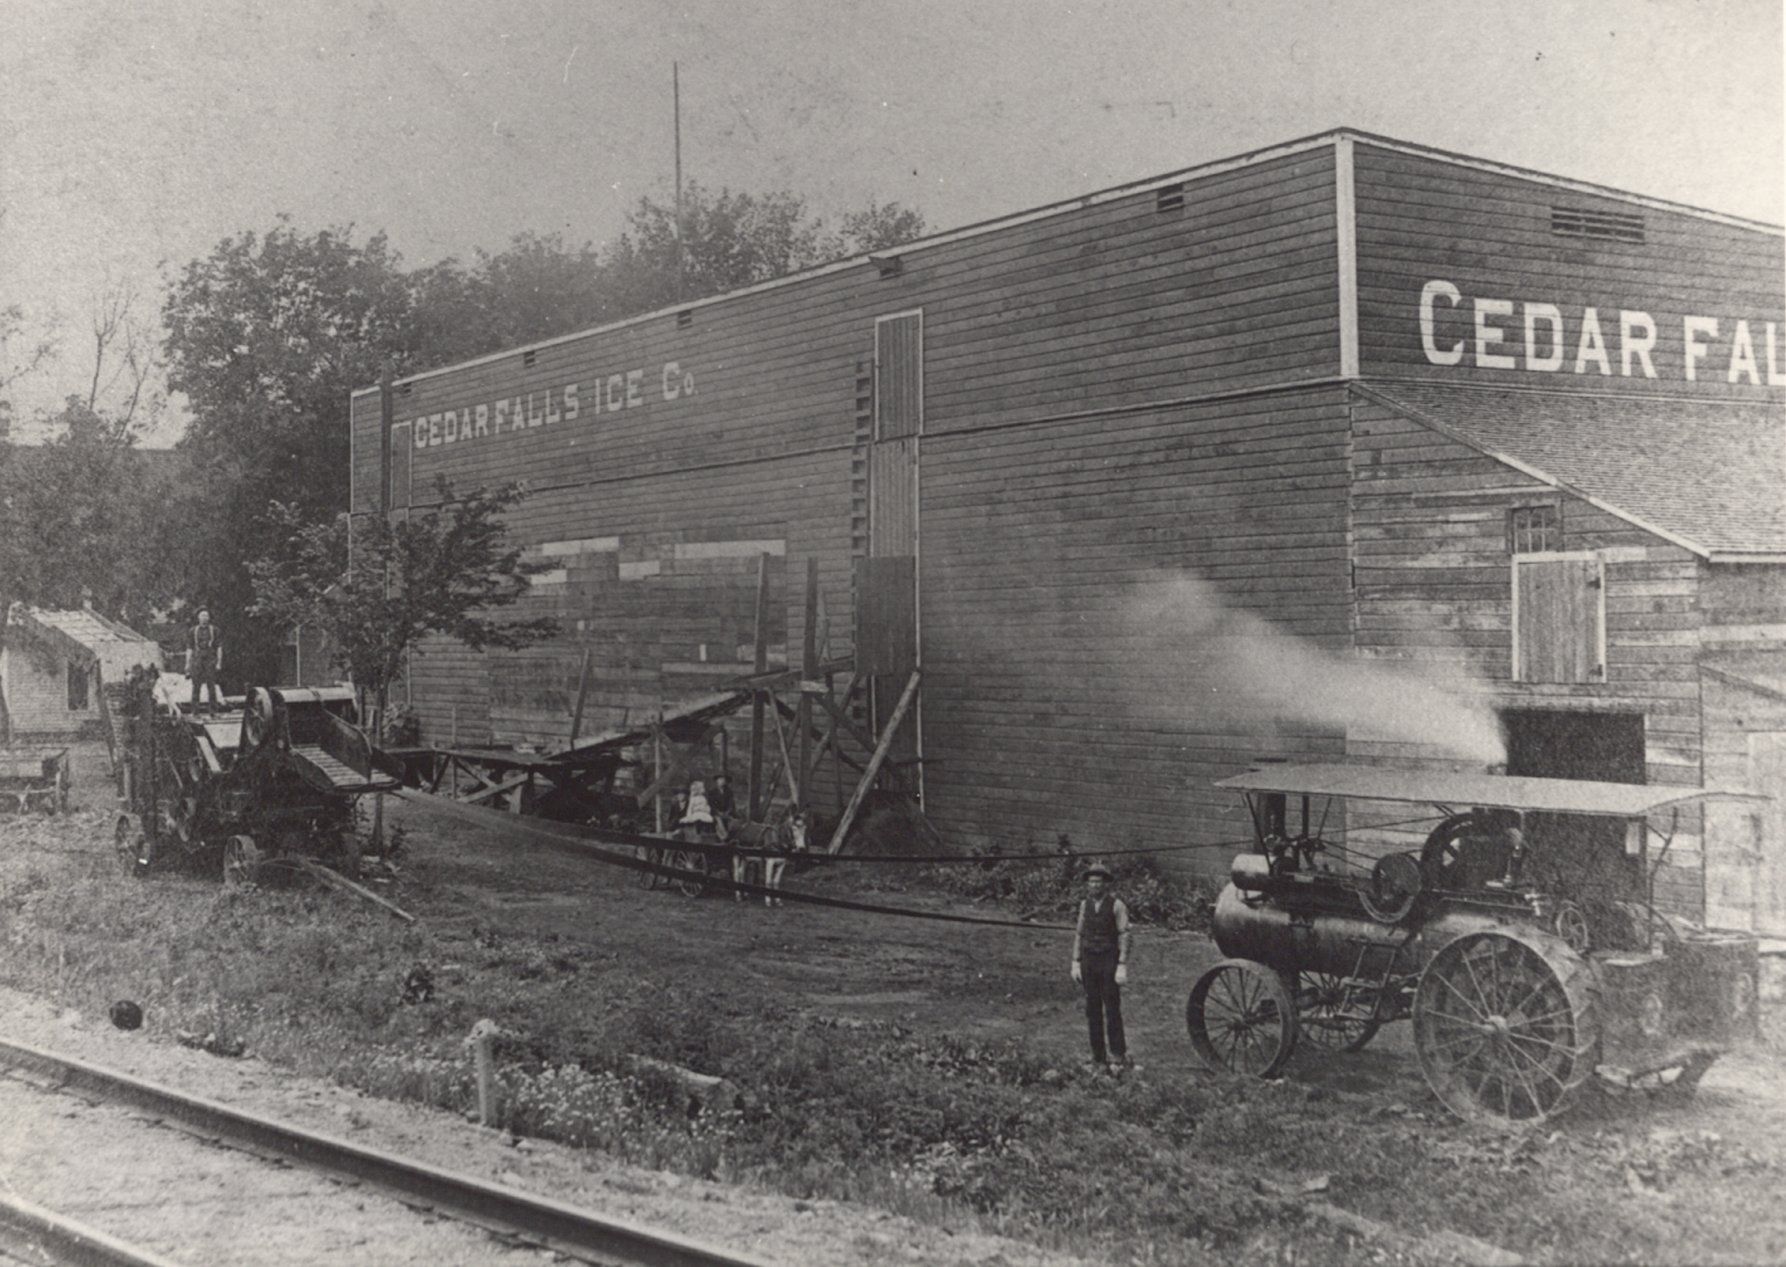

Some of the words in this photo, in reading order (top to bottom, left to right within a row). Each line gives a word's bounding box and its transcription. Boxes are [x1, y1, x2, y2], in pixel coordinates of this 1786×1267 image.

[1419, 279, 1658, 378] CEDAR
[415, 403, 489, 448] CEDAR
[495, 383, 580, 434] FALLS
[595, 369, 643, 415] ICE
